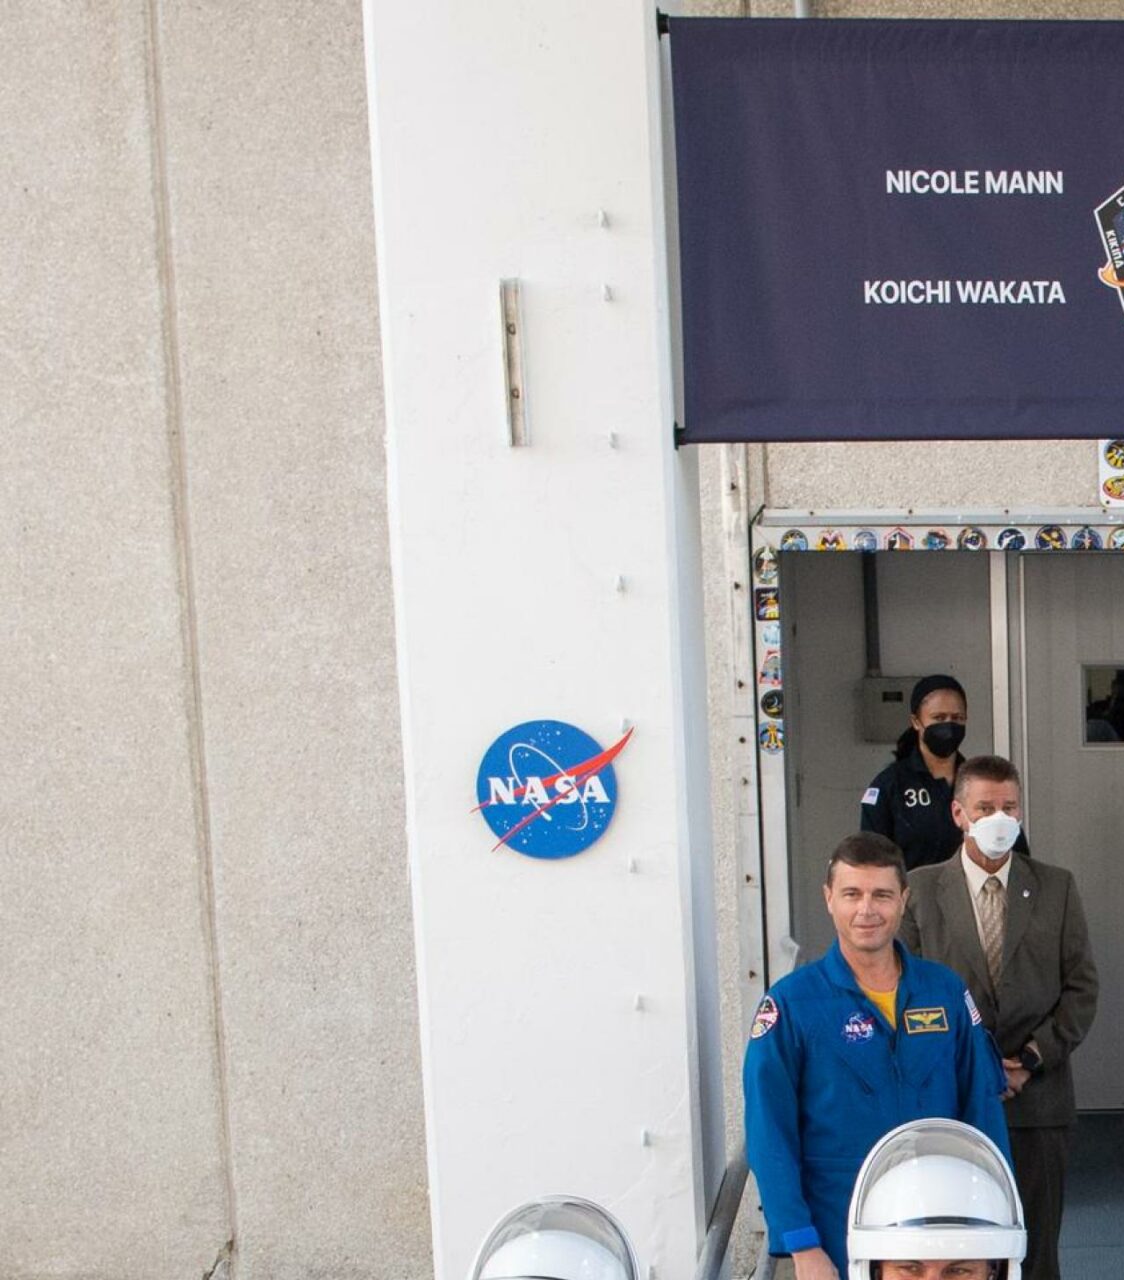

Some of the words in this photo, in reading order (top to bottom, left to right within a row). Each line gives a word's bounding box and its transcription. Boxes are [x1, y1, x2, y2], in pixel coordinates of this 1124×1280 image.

[886, 170, 980, 194] NICOLE
[984, 170, 1064, 194] MANN
[863, 280, 952, 304] KOICHI
[956, 280, 1067, 304] WAKATA
[487, 775, 611, 806] NASA
[904, 788, 931, 808] 30
